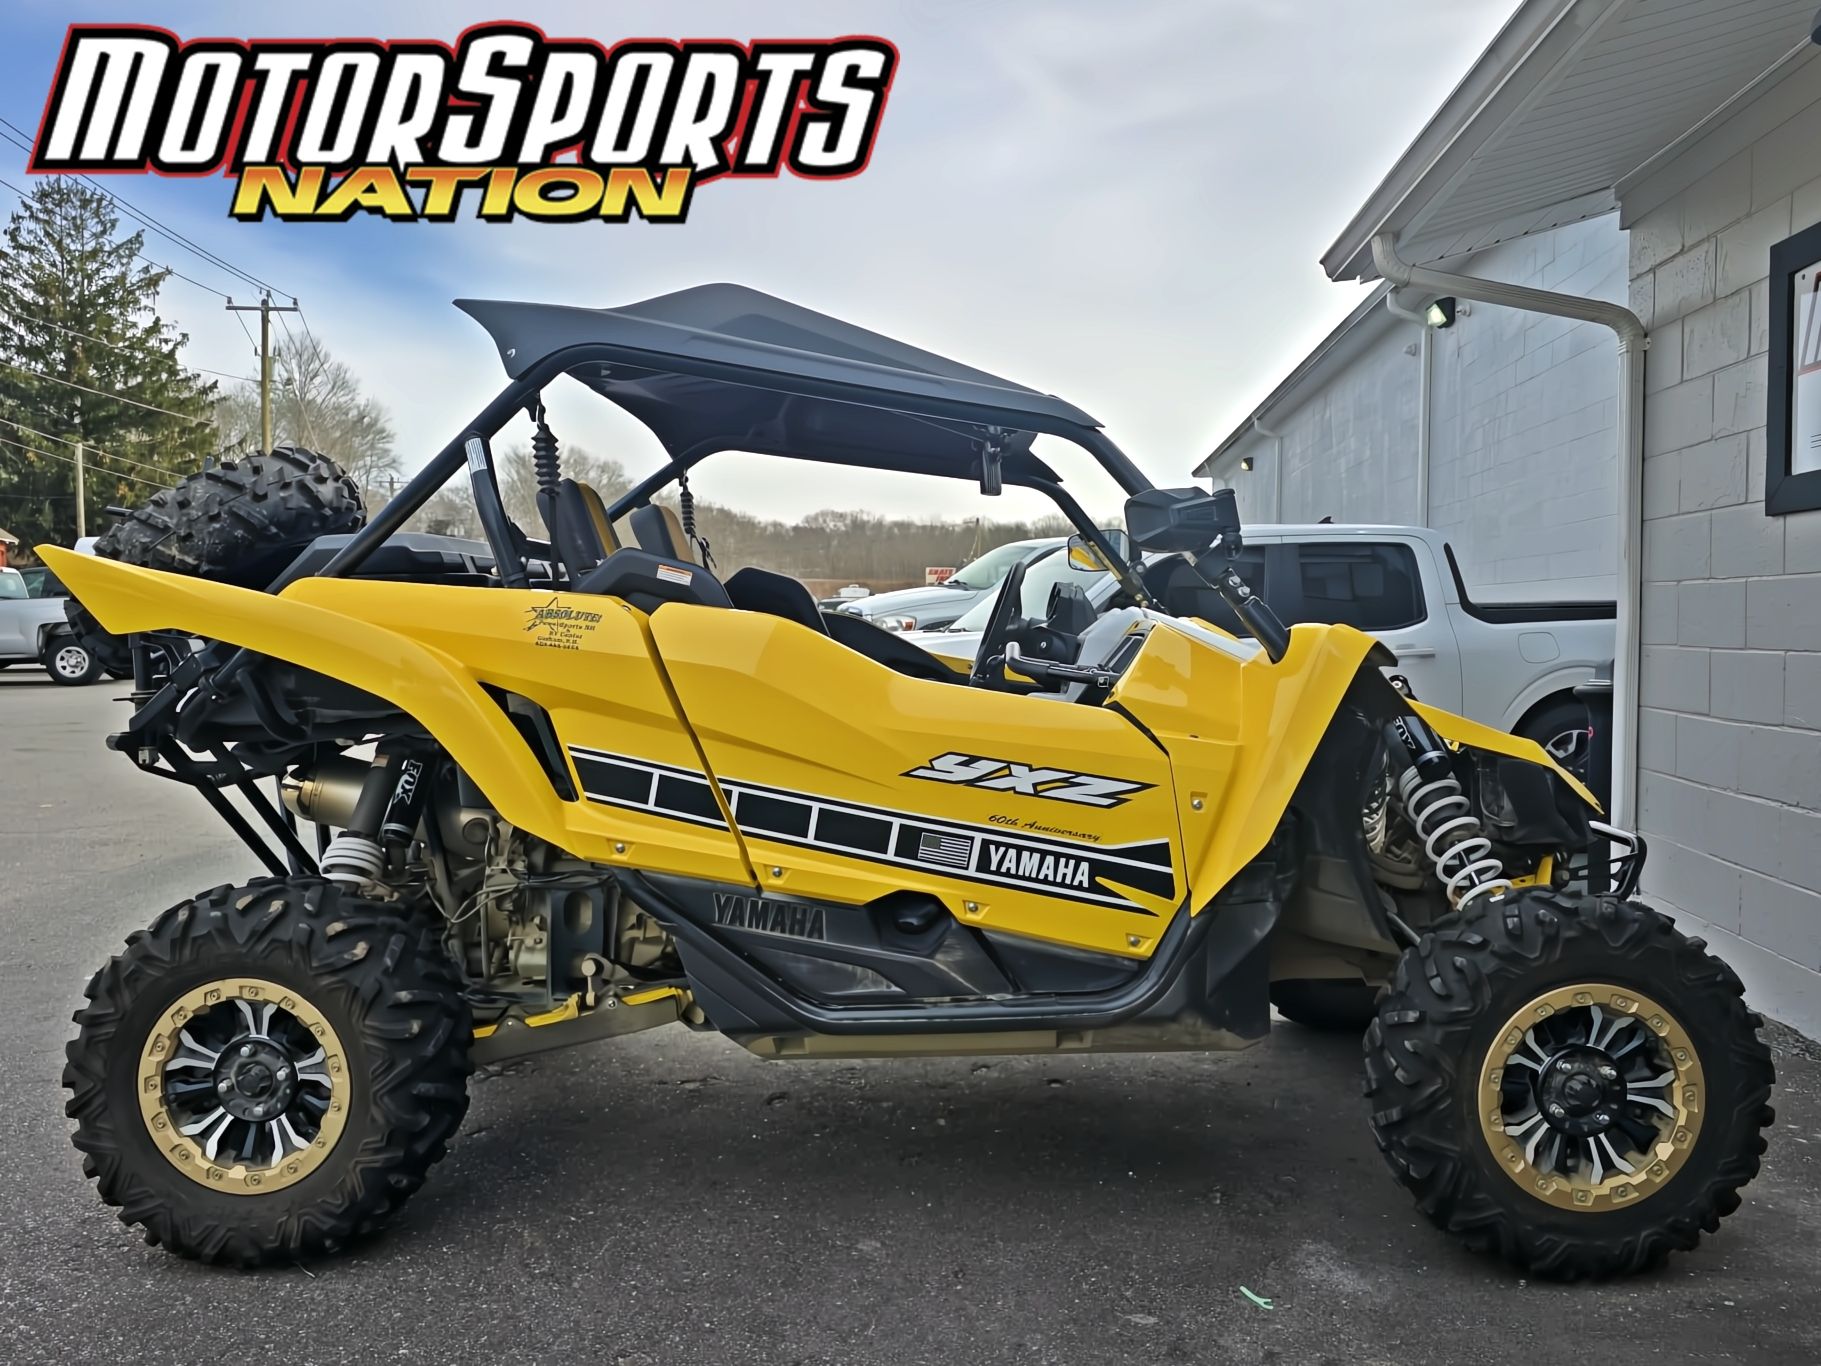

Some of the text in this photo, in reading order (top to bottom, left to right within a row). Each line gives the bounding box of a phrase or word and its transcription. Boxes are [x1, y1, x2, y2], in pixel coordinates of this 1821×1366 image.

[393, 759, 423, 805] FOX
[899, 751, 1158, 809] YXZ
[988, 814, 1103, 843] 60th Anniversary
[988, 844, 1090, 888] YAMAHA
[712, 892, 827, 942] YAMAHA
